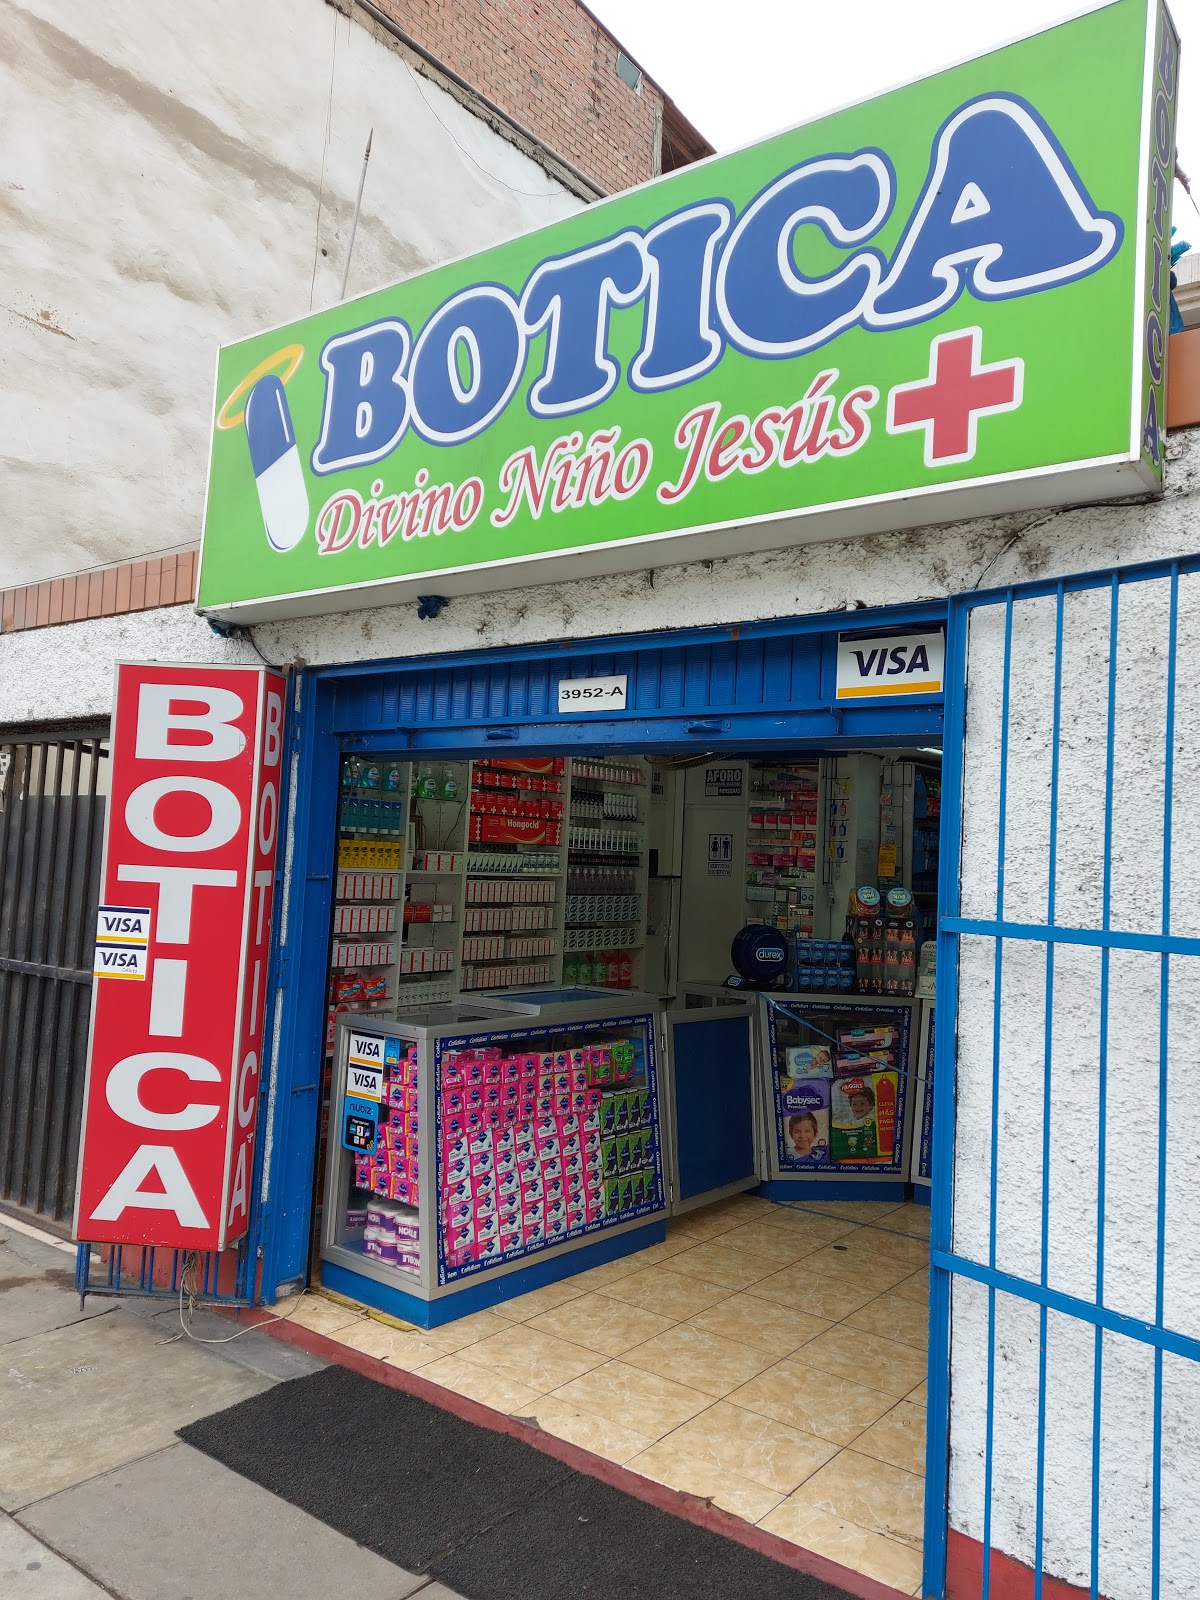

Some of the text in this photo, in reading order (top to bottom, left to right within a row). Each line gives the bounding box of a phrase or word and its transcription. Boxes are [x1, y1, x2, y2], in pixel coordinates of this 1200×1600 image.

[1143, 10, 1174, 466] BOTICA
[310, 91, 1125, 477] BOTICA
[315, 367, 880, 556] Divino Niño Jesús
[849, 644, 929, 676] VISA
[561, 686, 623, 699] 3952-A
[707, 770, 741, 782] AFORO
[508, 819, 539, 830] Hongocid
[102, 917, 142, 933] VISA
[89, 683, 245, 1229] BOTICA
[99, 952, 138, 967] VISA
[228, 691, 281, 1227] BOTICA
[758, 948, 784, 960] durex
[355, 1040, 379, 1057] VISA
[353, 1072, 376, 1089] VISA
[787, 1095, 821, 1106] Babysec
